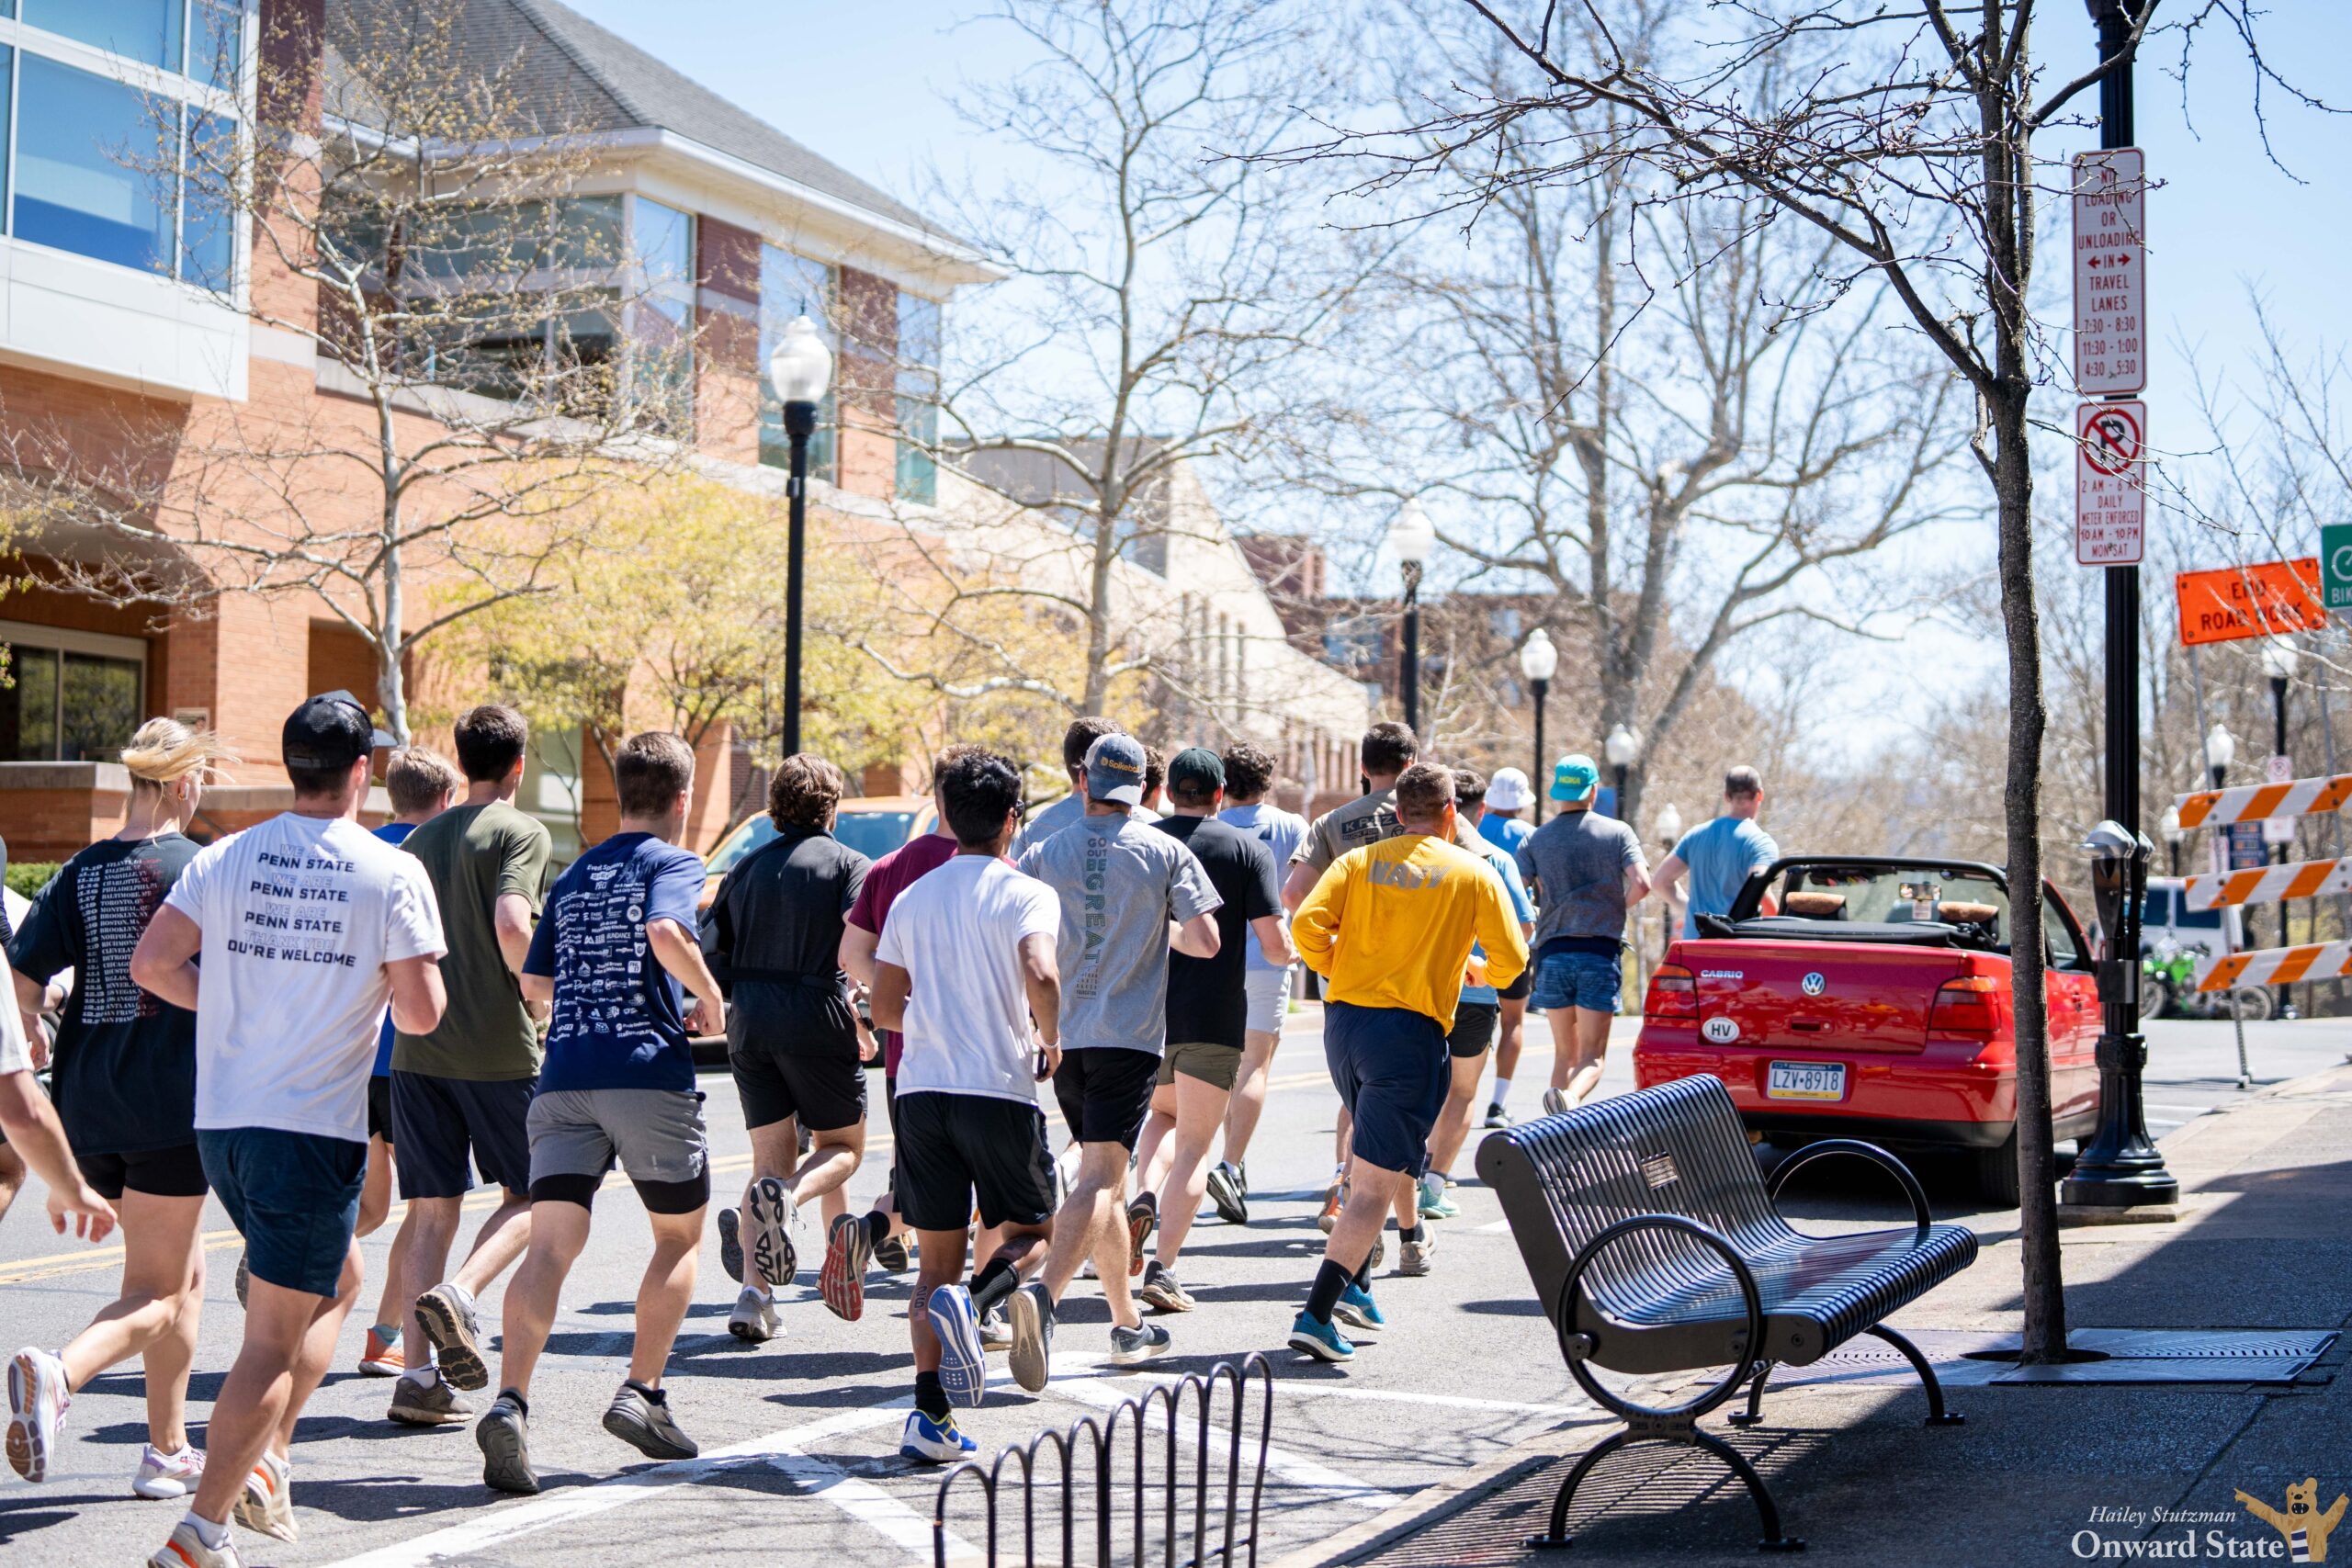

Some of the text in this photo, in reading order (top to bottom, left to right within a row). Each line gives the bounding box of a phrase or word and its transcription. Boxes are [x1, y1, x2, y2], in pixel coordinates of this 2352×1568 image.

[2085, 189, 2132, 207] LOADNG
[2101, 211, 2117, 227] OR
[2078, 231, 2140, 250] UNLOADING
[2104, 254, 2115, 269] IN
[2089, 275, 2130, 291] TRAVEL
[2091, 295, 2128, 312] LANES
[2084, 318, 2104, 333] 7:30
[2115, 316, 2136, 332] 8:30
[2083, 340, 2106, 355] 11:30
[2118, 338, 2138, 353] 1:00
[2085, 359, 2136, 377] 4:30 5:30
[2081, 480, 2087, 493] 2
[2092, 479, 2104, 492] AM
[2098, 495, 2123, 508] DAILY
[2082, 510, 2139, 525] METER ENFORCED
[2200, 602, 2304, 632] ROAD WOK
[1087, 837, 1107, 848] GO
[280, 844, 341, 860] WE AE
[1087, 849, 1107, 857] OUT
[258, 852, 300, 870] PENN
[1086, 858, 1107, 871] BE
[271, 872, 334, 888] WE ARE
[1368, 859, 1451, 890] NAVY
[250, 881, 349, 903] PENN STATE.
[266, 902, 327, 919] WE ARE
[1085, 873, 1105, 964] GREAT
[244, 911, 344, 933] PENN STATE.
[243, 930, 336, 951] THANK YOU
[281, 948, 356, 967] WELCOME
[1701, 969, 1744, 979] CABRIO
[1711, 1023, 1731, 1037] HV
